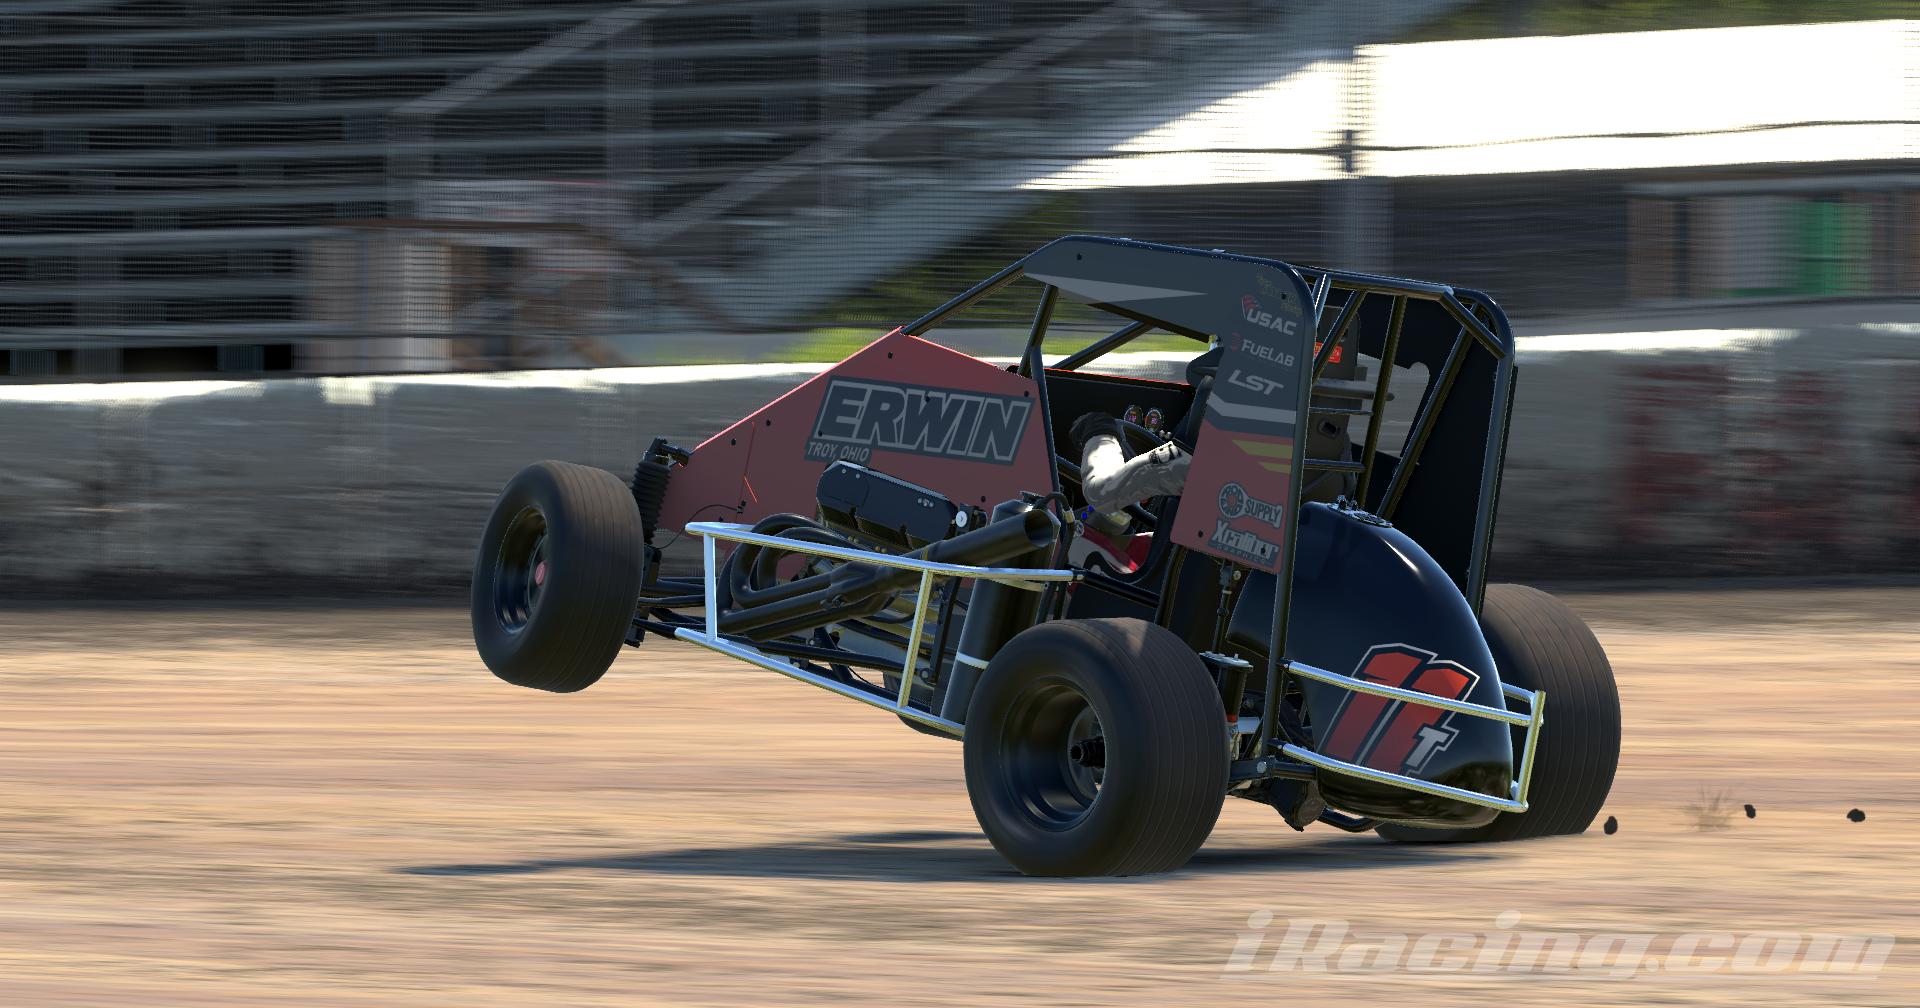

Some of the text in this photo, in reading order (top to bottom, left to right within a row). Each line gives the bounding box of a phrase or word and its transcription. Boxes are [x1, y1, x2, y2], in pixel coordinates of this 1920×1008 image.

[1246, 308, 1297, 336] USAC
[1241, 339, 1295, 367] FUELAB
[1228, 369, 1284, 395] LST
[813, 379, 1032, 462] ERWIN
[840, 445, 870, 462] OHIO
[1245, 498, 1281, 522] SUPPLY
